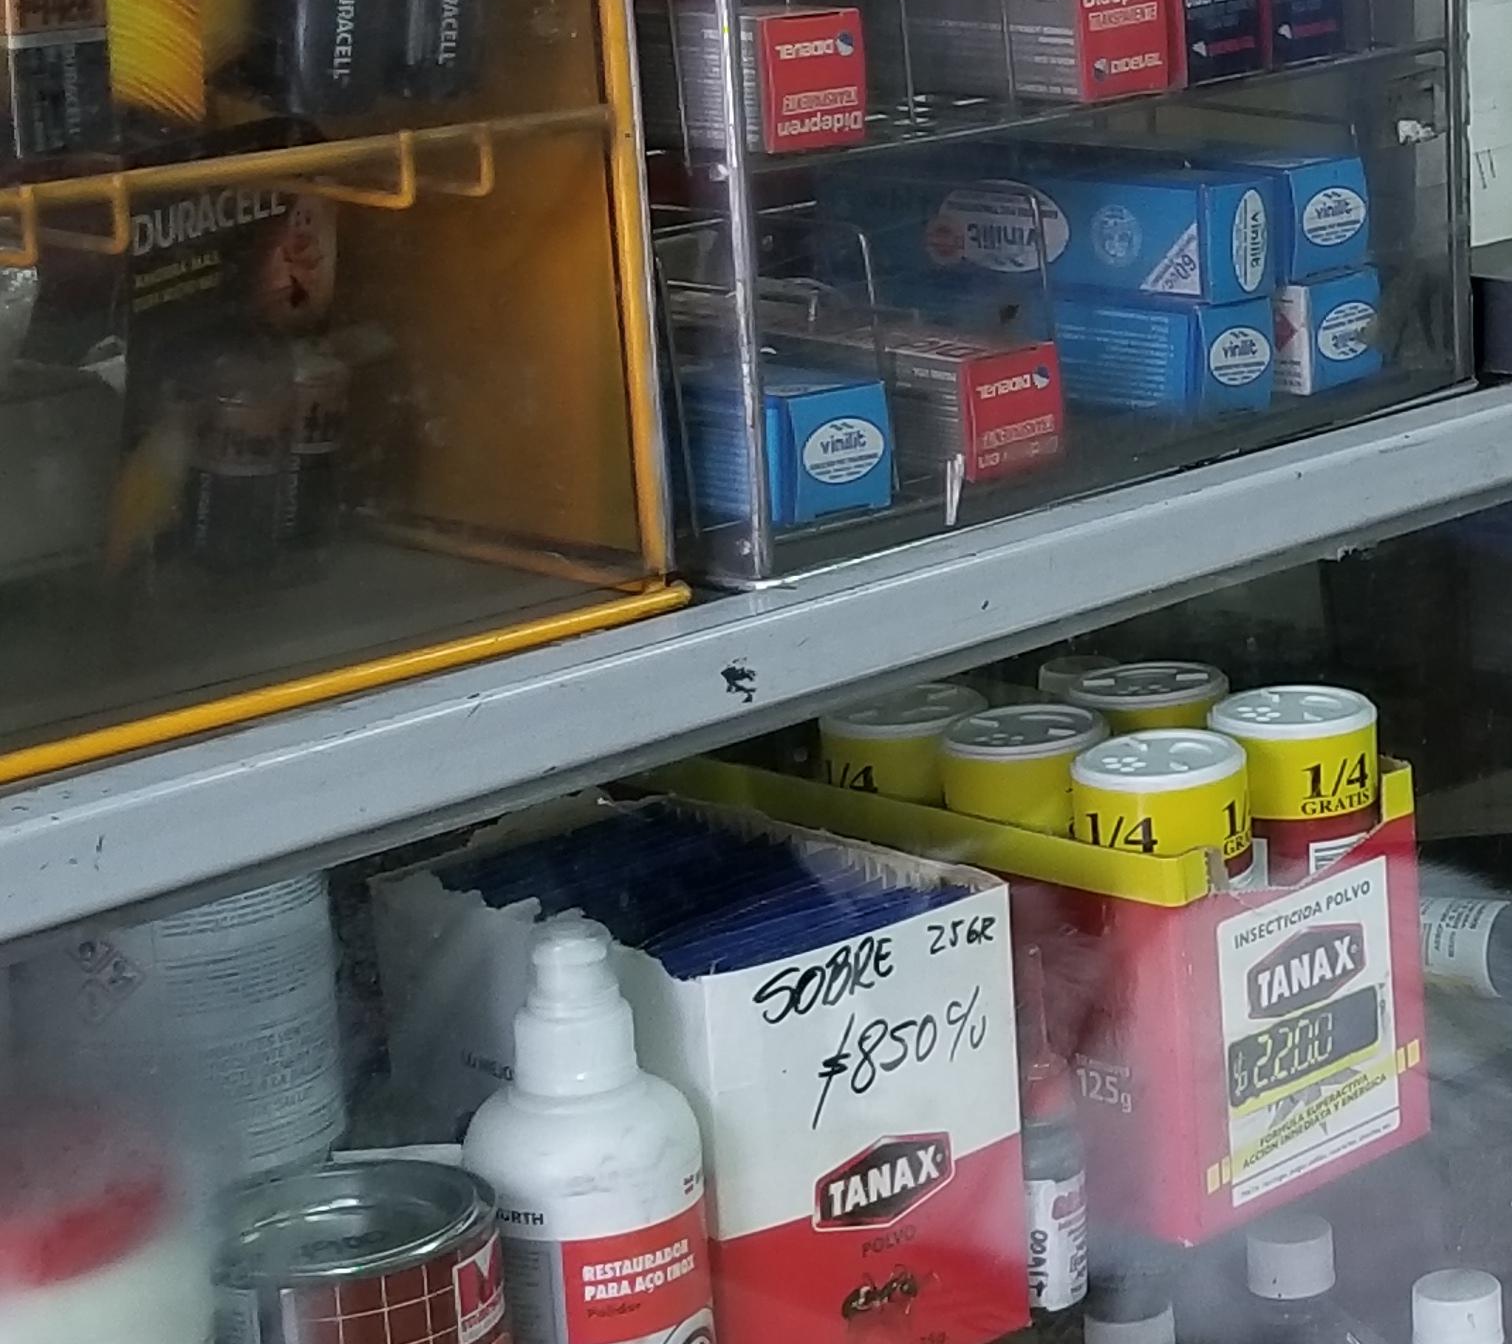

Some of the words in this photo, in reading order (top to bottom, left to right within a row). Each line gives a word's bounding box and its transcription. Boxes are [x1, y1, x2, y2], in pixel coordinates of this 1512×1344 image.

[776, 110, 863, 137] Didepren
[820, 428, 868, 456] vinilit
[1302, 751, 1368, 800] 1/4
[1302, 787, 1371, 816] GRATIS
[1233, 900, 1323, 950] INSECTICIDA
[1326, 879, 1372, 911] POLVO
[753, 935, 894, 1024] SOBRE
[1256, 934, 1356, 1009] TANAX
[829, 1142, 940, 1218] TANAX
[582, 1238, 690, 1283] RESTAURADOR
[583, 1281, 632, 1302] PARA
[634, 1273, 665, 1295] AÇO
